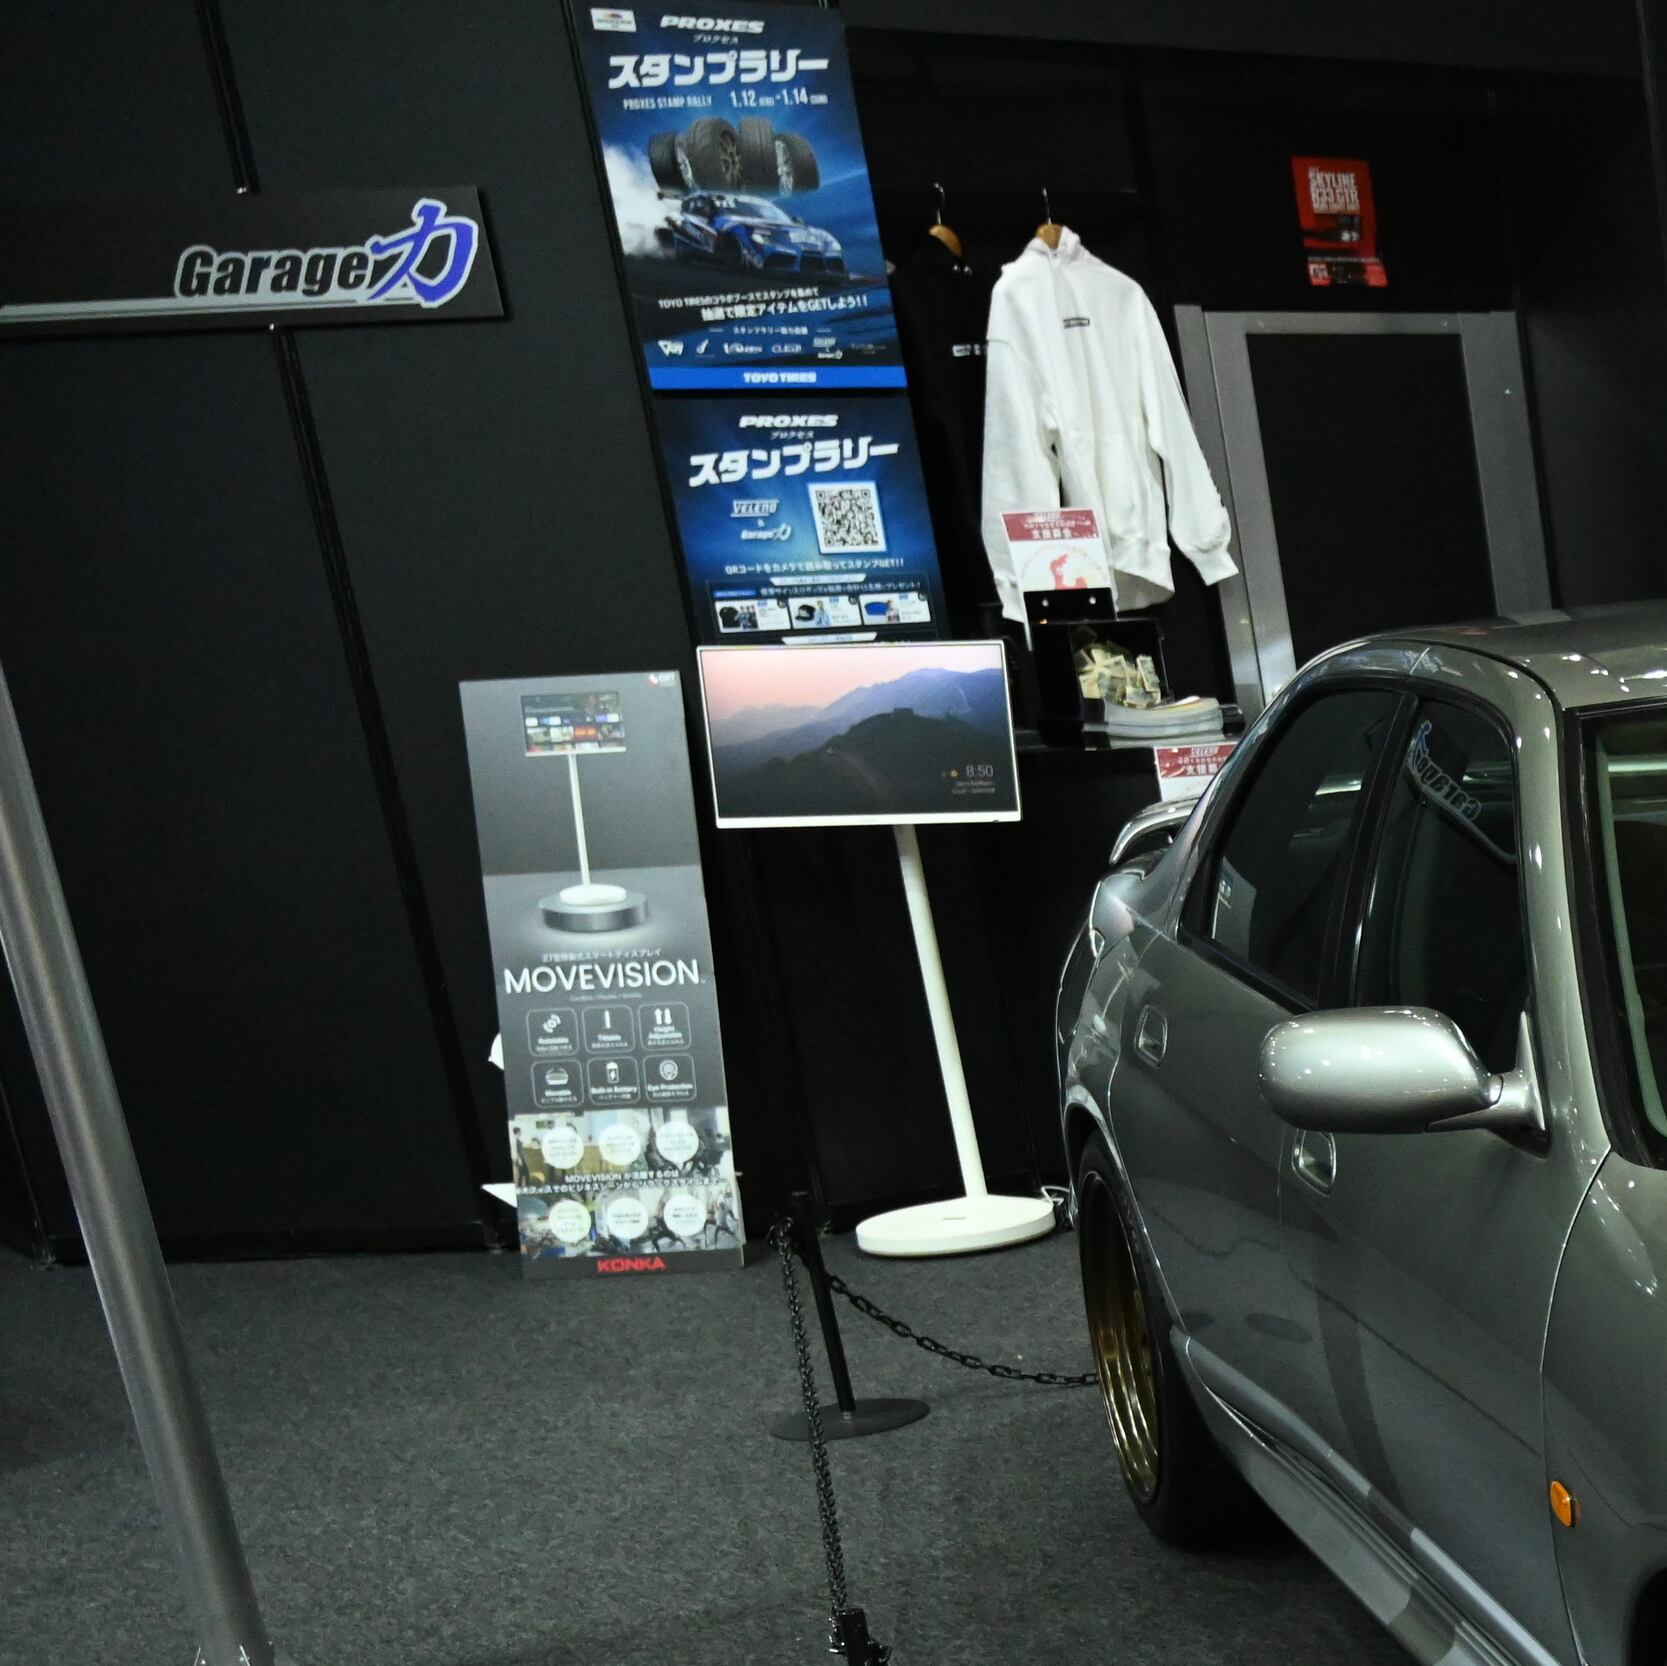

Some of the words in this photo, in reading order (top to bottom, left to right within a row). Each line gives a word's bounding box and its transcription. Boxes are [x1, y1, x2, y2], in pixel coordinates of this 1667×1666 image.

[660, 15, 765, 34] PROXES
[608, 49, 829, 89] スタンプラリー
[743, 372, 778, 383] TOYO
[739, 414, 839, 428] PROXES
[688, 436, 899, 487] スタンプラリー
[966, 764, 994, 778] 8:50
[503, 958, 700, 994] MOVEVISION
[597, 1256, 667, 1272] KONKA
